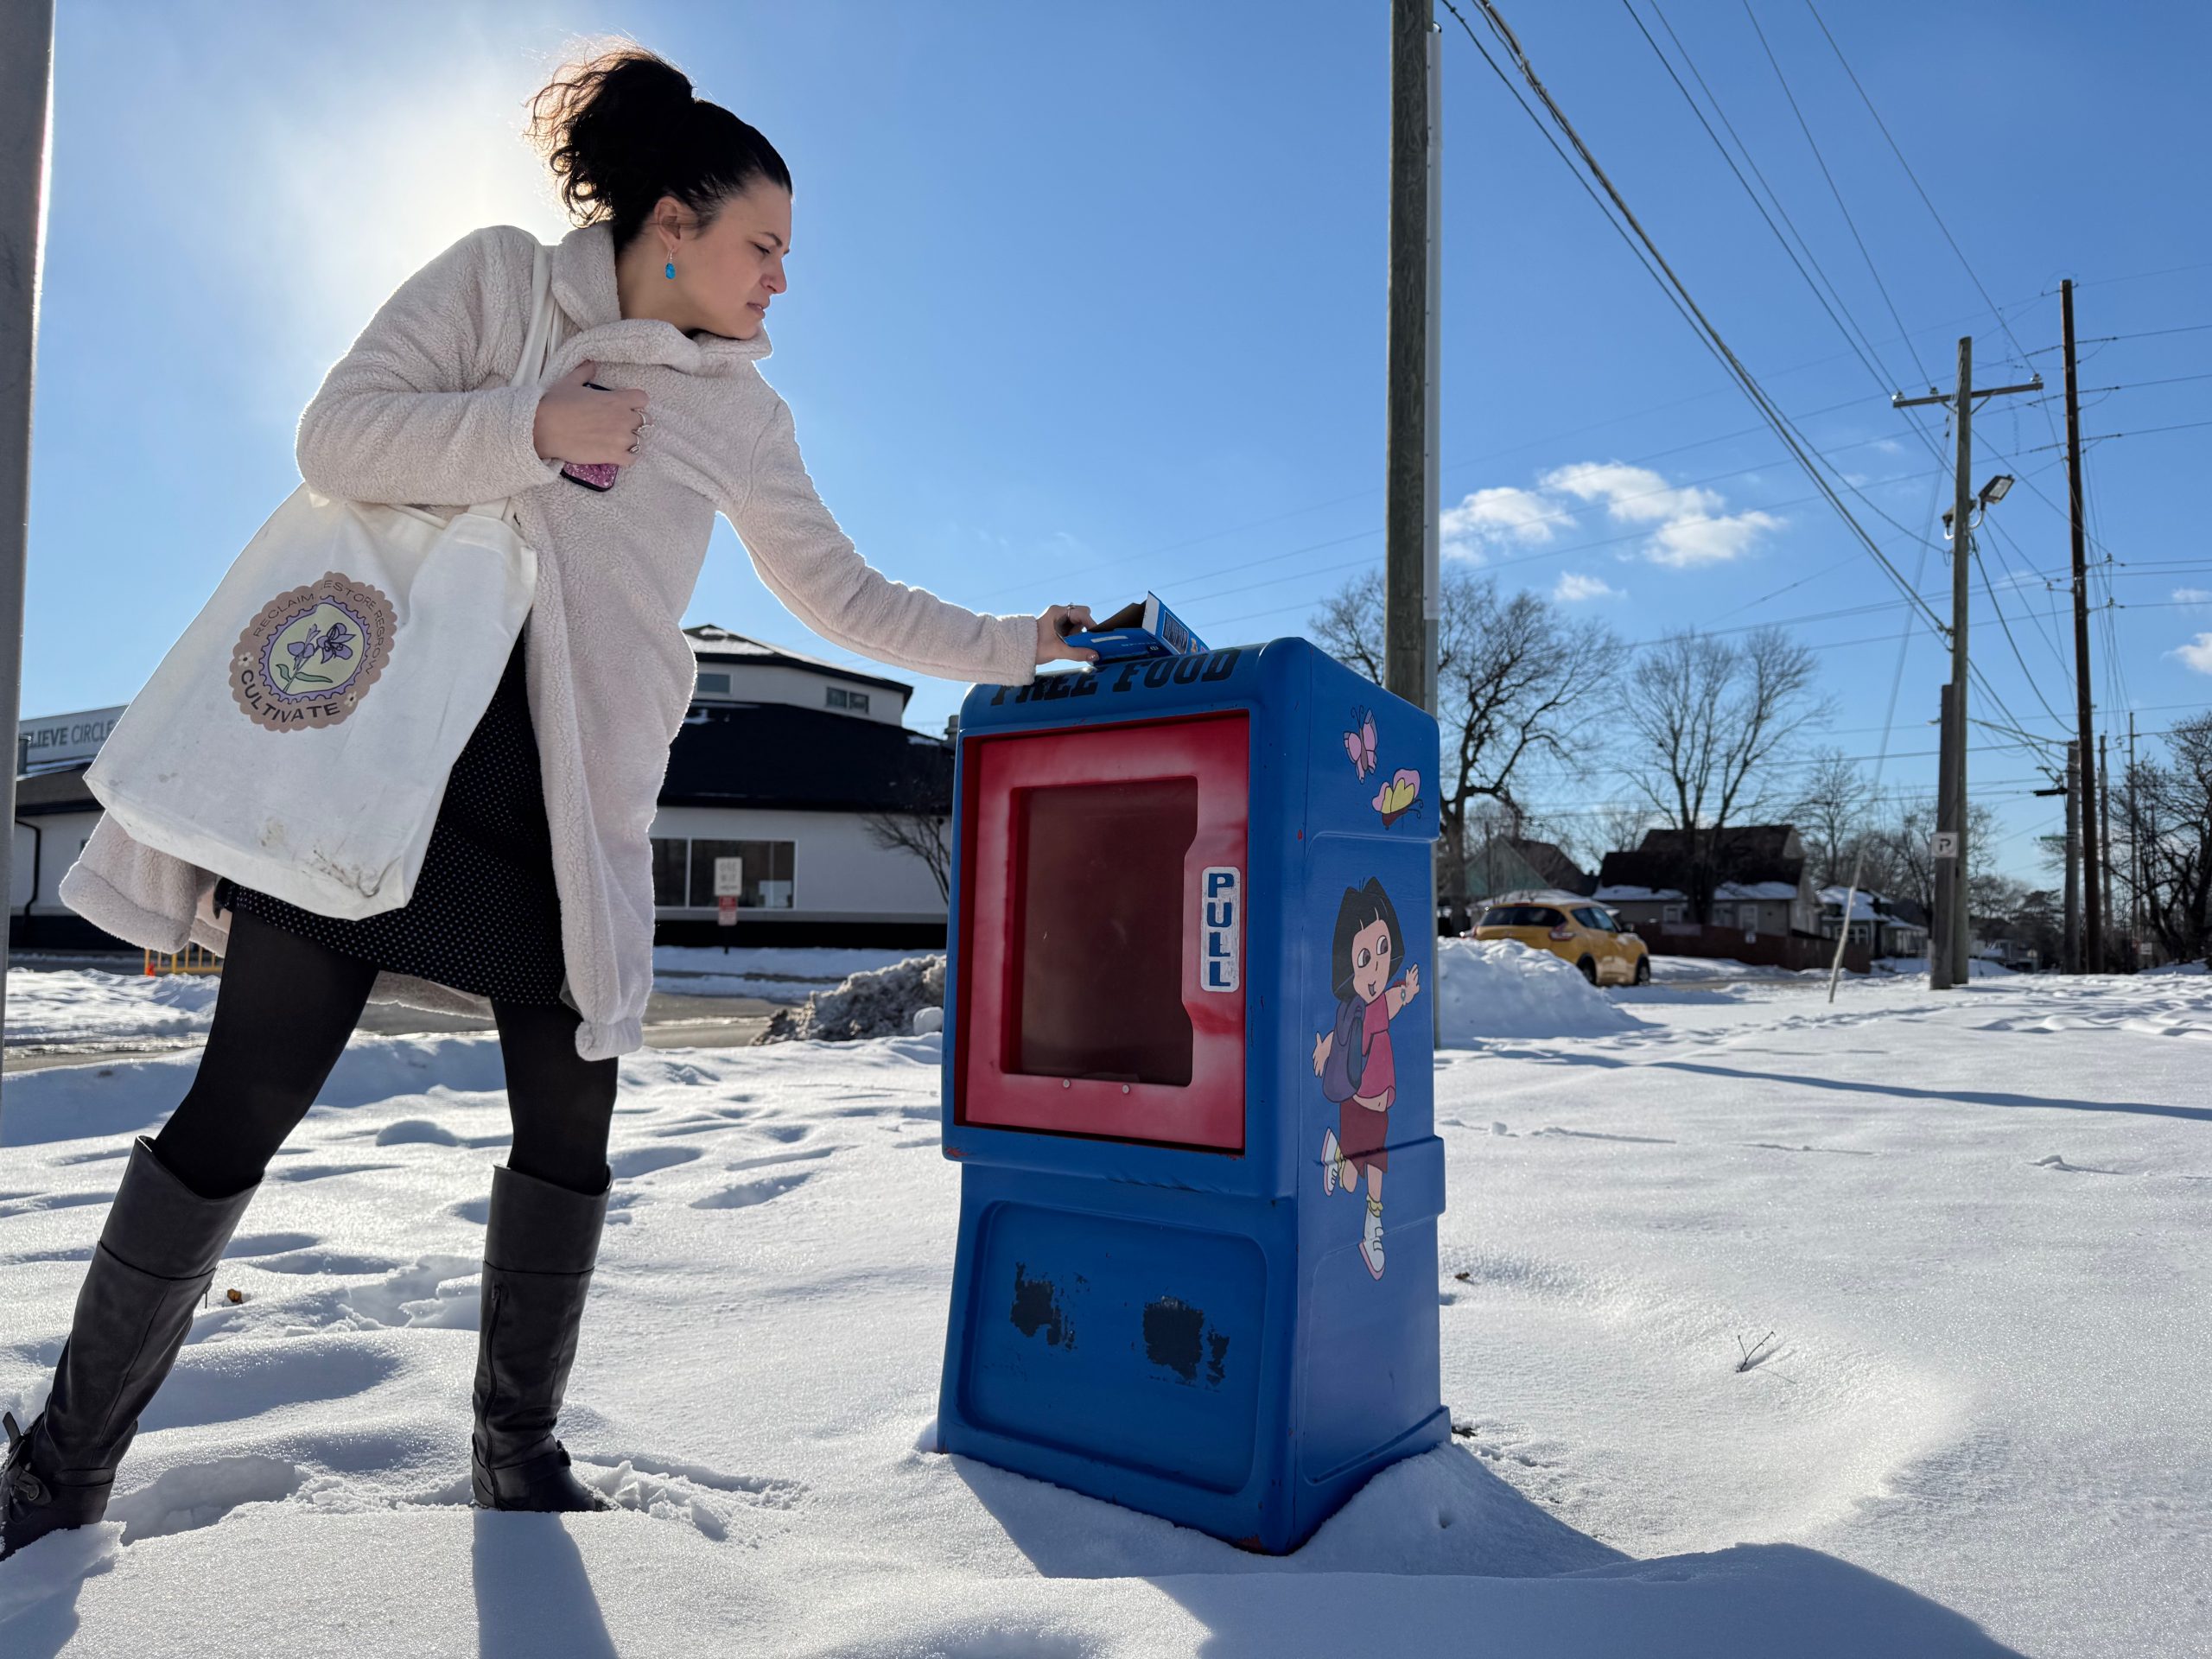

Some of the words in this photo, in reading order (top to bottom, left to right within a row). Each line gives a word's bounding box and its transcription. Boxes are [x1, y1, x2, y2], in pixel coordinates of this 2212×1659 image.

[253, 593, 315, 638] RECLAIM
[323, 580, 377, 612] ESTORE
[365, 610, 385, 675] REGROW
[241, 670, 340, 723] CULTIVATE
[1112, 649, 1243, 693] FOOD
[1206, 873, 1235, 987] PULL
